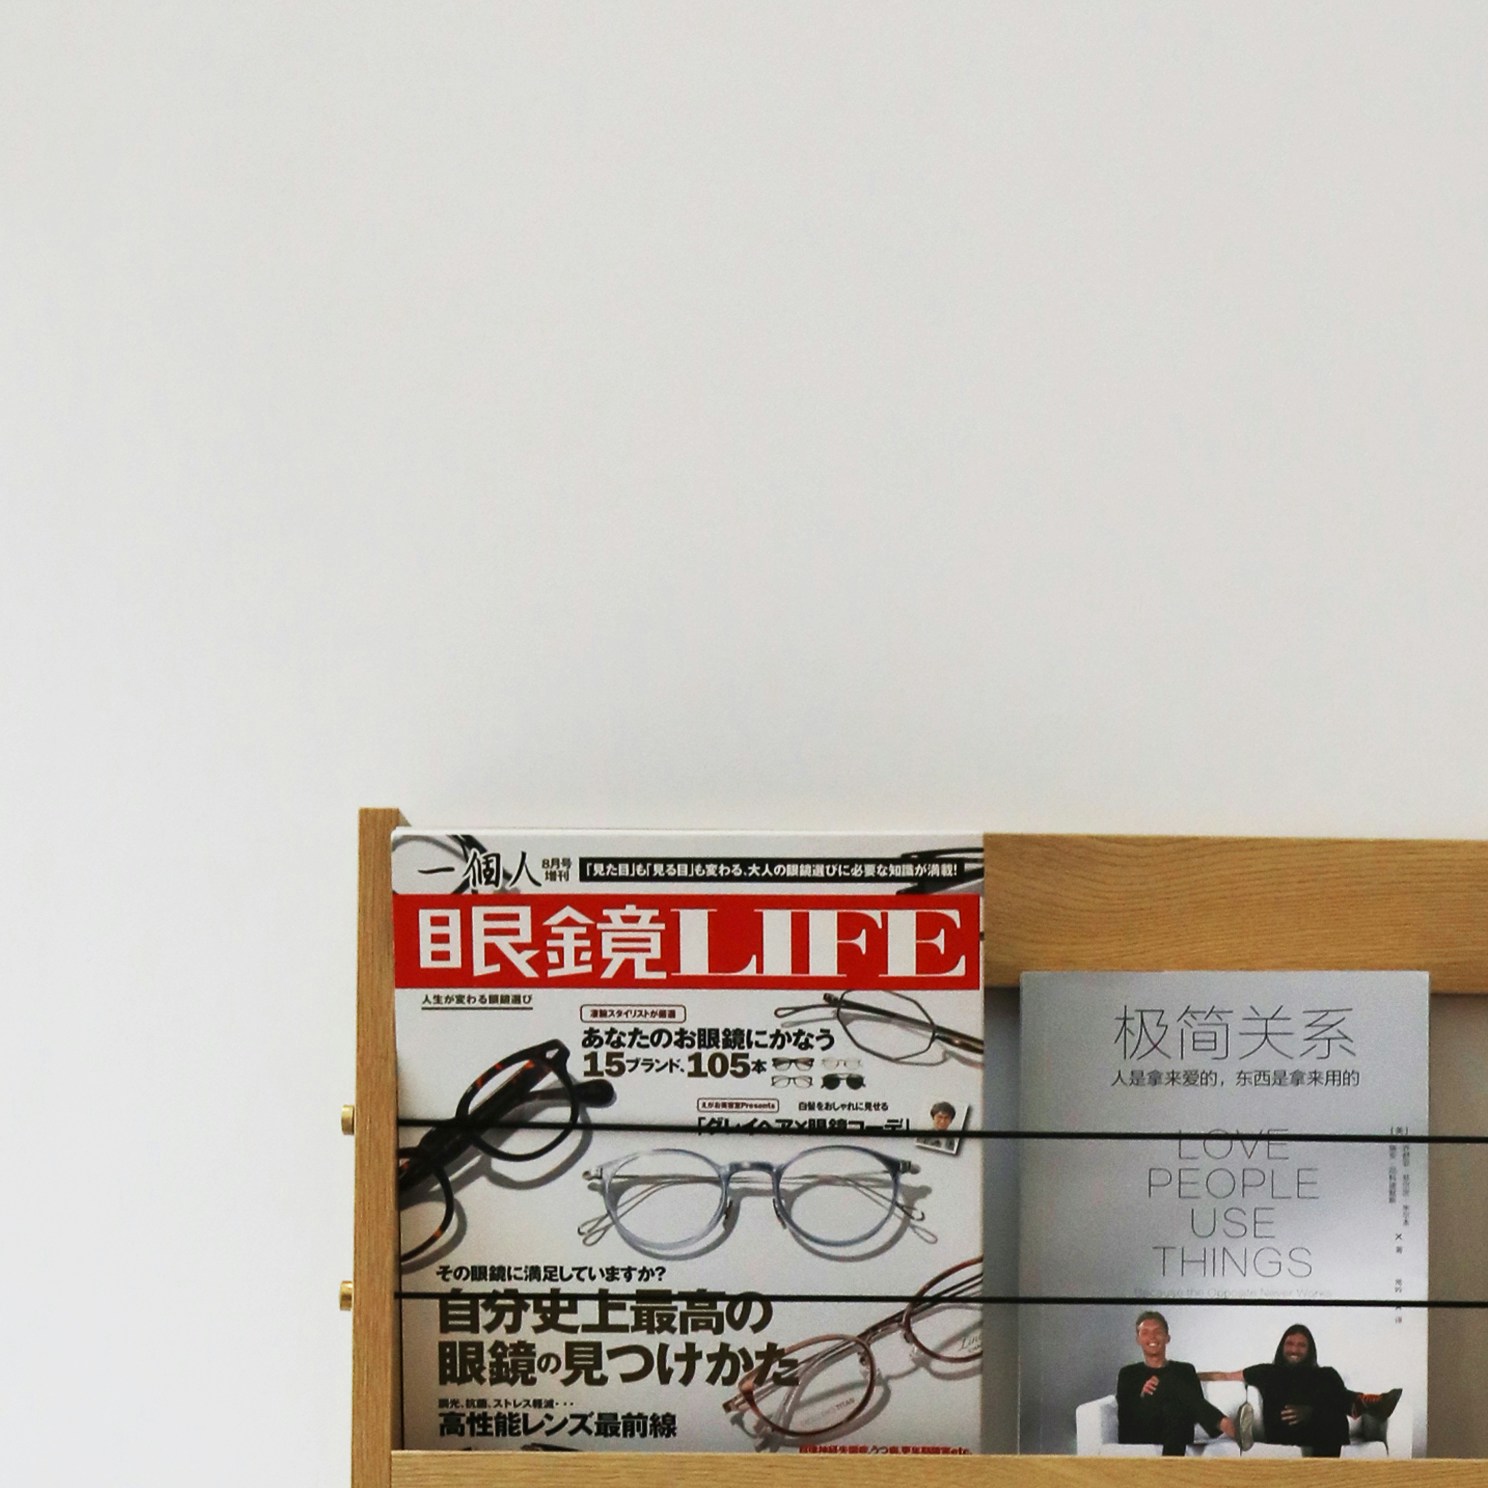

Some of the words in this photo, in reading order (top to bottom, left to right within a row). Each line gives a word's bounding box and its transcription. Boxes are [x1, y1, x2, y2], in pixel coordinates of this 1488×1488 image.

[417, 850, 542, 888] 一個人
[542, 858, 572, 869] 8月号
[544, 870, 570, 882] 増刊
[581, 1027, 835, 1051] あなたのお眼鏡にかなう
[1114, 1004, 1357, 1061] 极简关系
[1178, 1128, 1290, 1160] LOVE
[1148, 1167, 1320, 1199] PEOPLE
[1190, 1206, 1276, 1239] USE
[1152, 1246, 1314, 1278] THINGS
[437, 1287, 774, 1335] 自分史上最高の
[437, 1339, 801, 1387] 眼鏡の見つけかた
[438, 1411, 678, 1439] 高性能レンズ最前線
